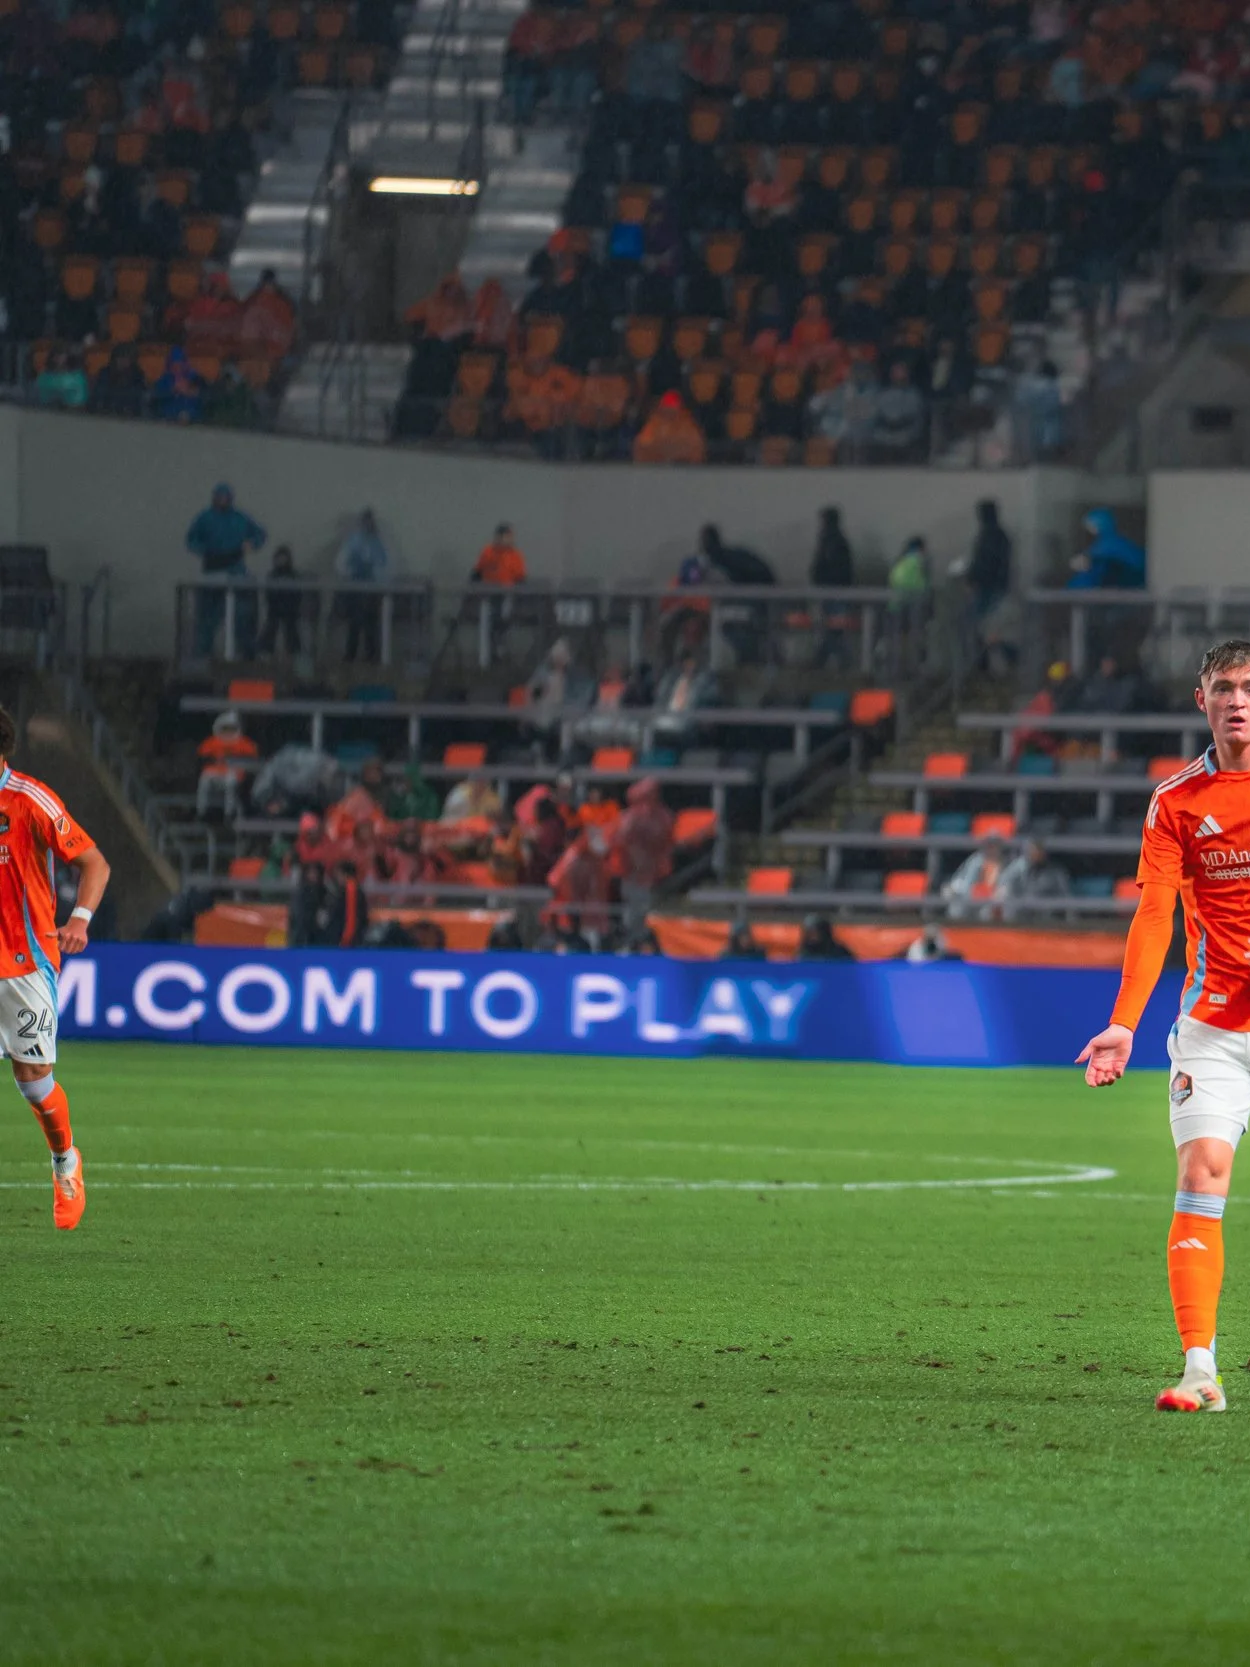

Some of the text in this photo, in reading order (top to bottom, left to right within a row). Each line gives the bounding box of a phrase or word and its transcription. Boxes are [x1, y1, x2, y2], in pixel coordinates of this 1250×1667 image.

[1200, 850, 1226, 867] MD
[411, 970, 538, 1040] TO
[571, 973, 807, 1044] PLAY
[17, 1008, 53, 1039] 24
